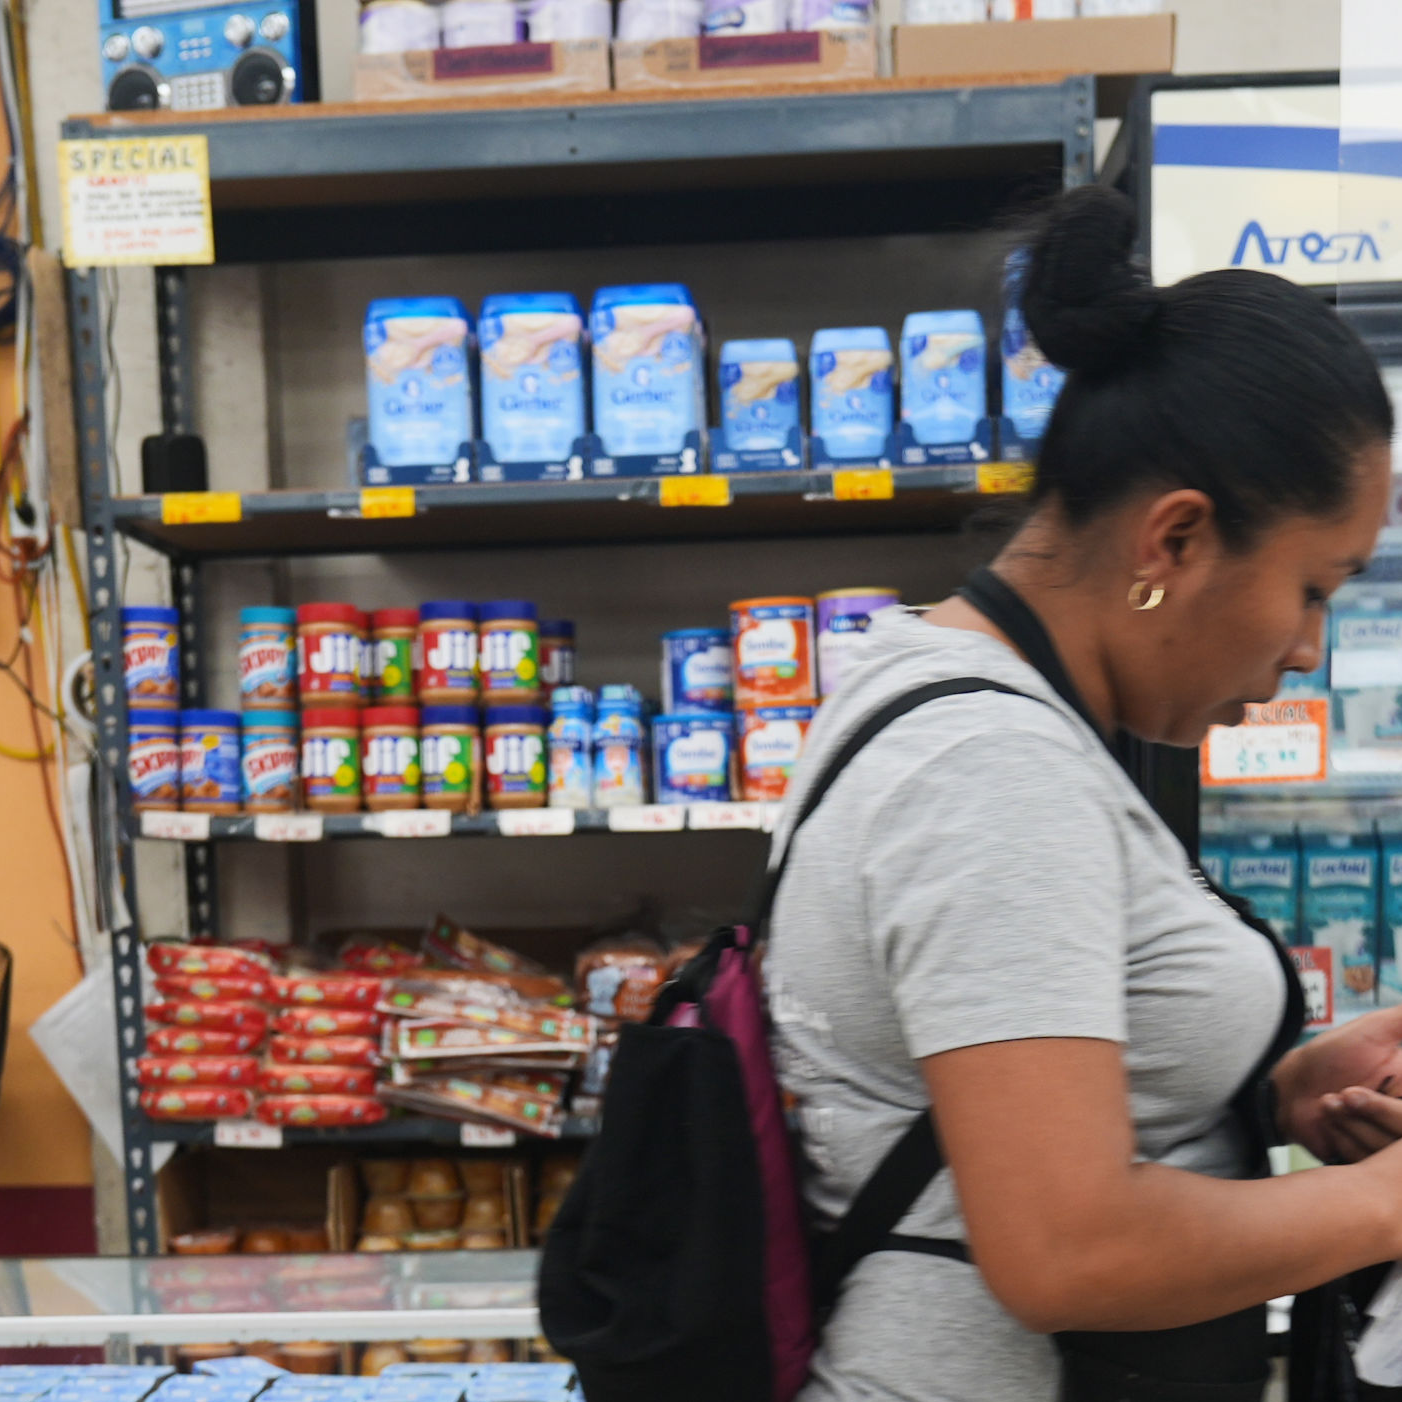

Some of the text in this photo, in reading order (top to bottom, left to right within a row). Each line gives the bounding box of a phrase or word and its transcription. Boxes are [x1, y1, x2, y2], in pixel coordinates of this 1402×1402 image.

[71, 146, 195, 171] SPECIAL
[362, 736, 419, 777] Jif
[487, 735, 543, 775] Jif
